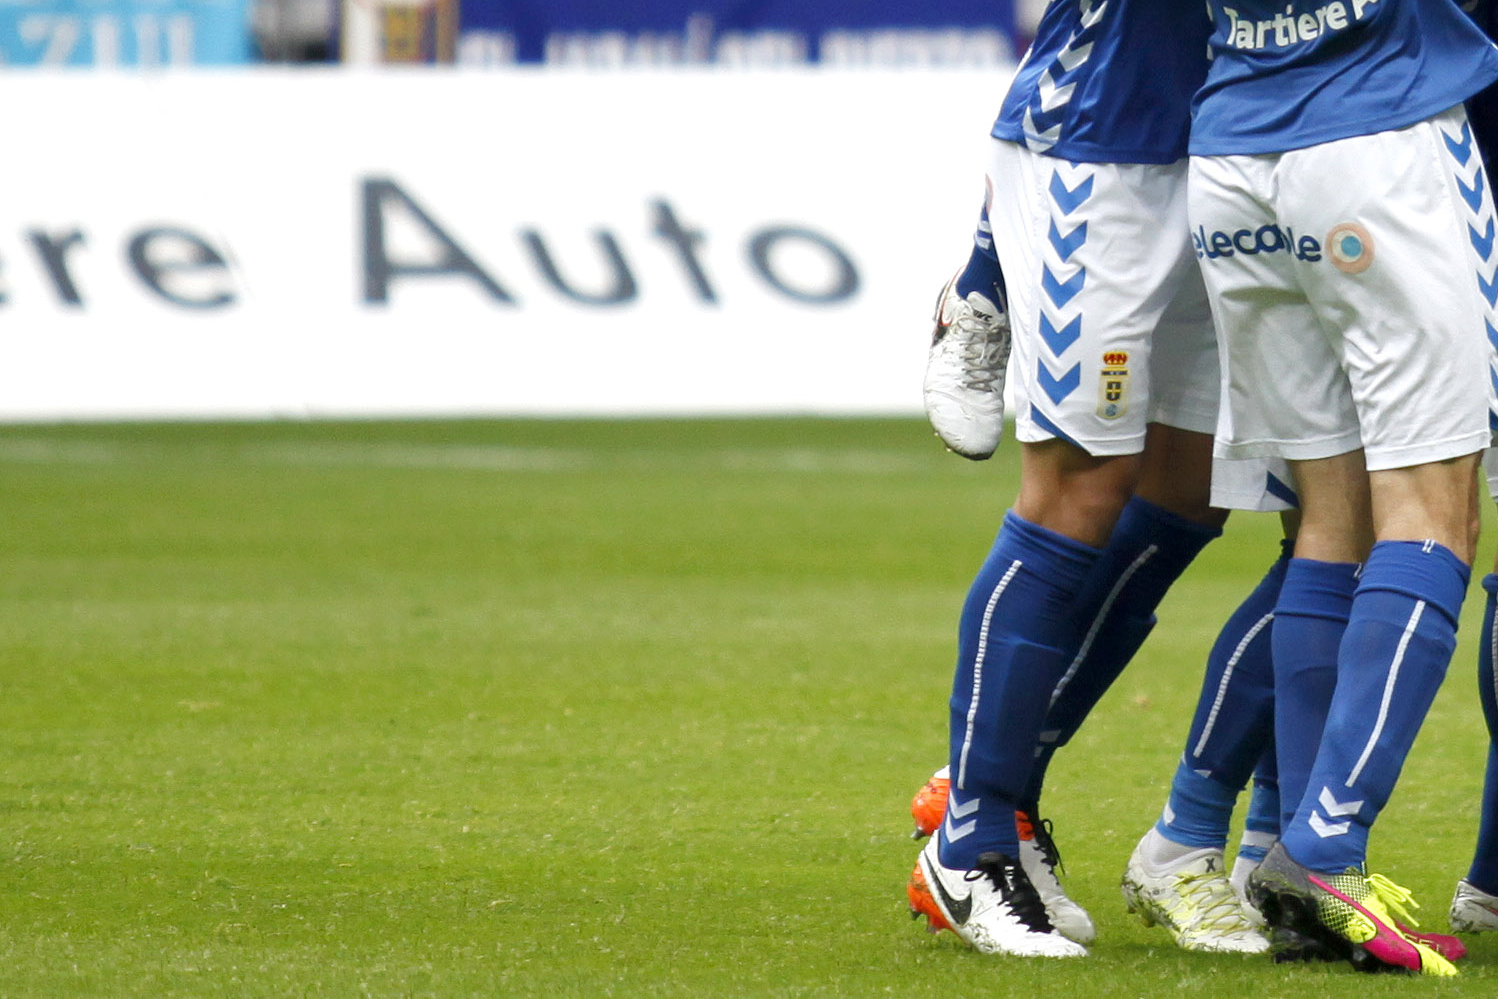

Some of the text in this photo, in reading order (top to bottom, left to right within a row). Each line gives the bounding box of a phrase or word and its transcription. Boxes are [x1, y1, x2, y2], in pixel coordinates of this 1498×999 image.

[1224, 1, 1348, 49] Tartiere
[0, 174, 862, 311] re Auto
